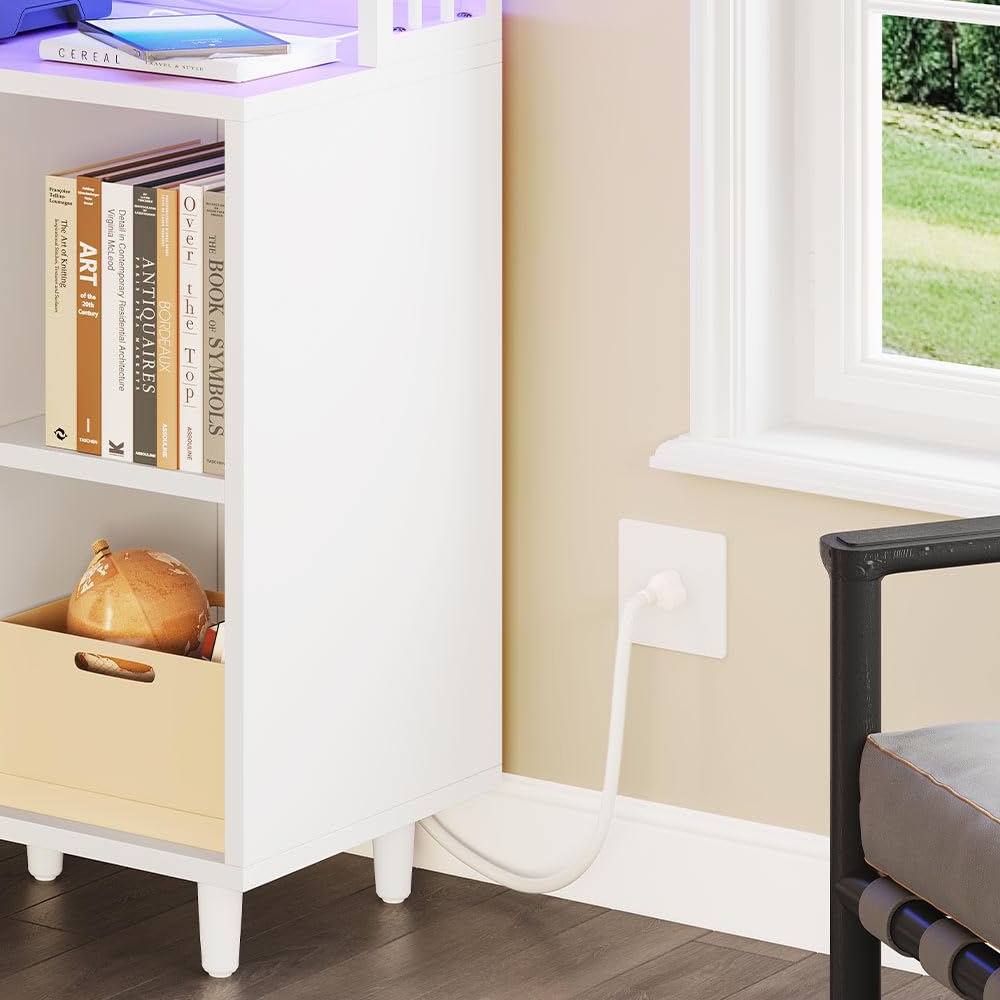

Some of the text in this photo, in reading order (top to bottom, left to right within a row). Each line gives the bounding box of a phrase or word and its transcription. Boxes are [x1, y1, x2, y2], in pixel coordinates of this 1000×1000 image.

[58, 47, 121, 65] CEREAL
[60, 249, 68, 258] of
[107, 208, 115, 271] Virginia McLeod
[59, 258, 68, 288] Knitting
[79, 240, 98, 287] ART
[77, 308, 98, 318] Century
[87, 292, 97, 300] the
[117, 209, 127, 392] Detail in Contemporary Residential Architecture
[140, 257, 156, 394] ANTIQUAIRES
[159, 301, 171, 373] BORDEAUX
[208, 235, 225, 436] THE BOOK OF SYMBOLS
